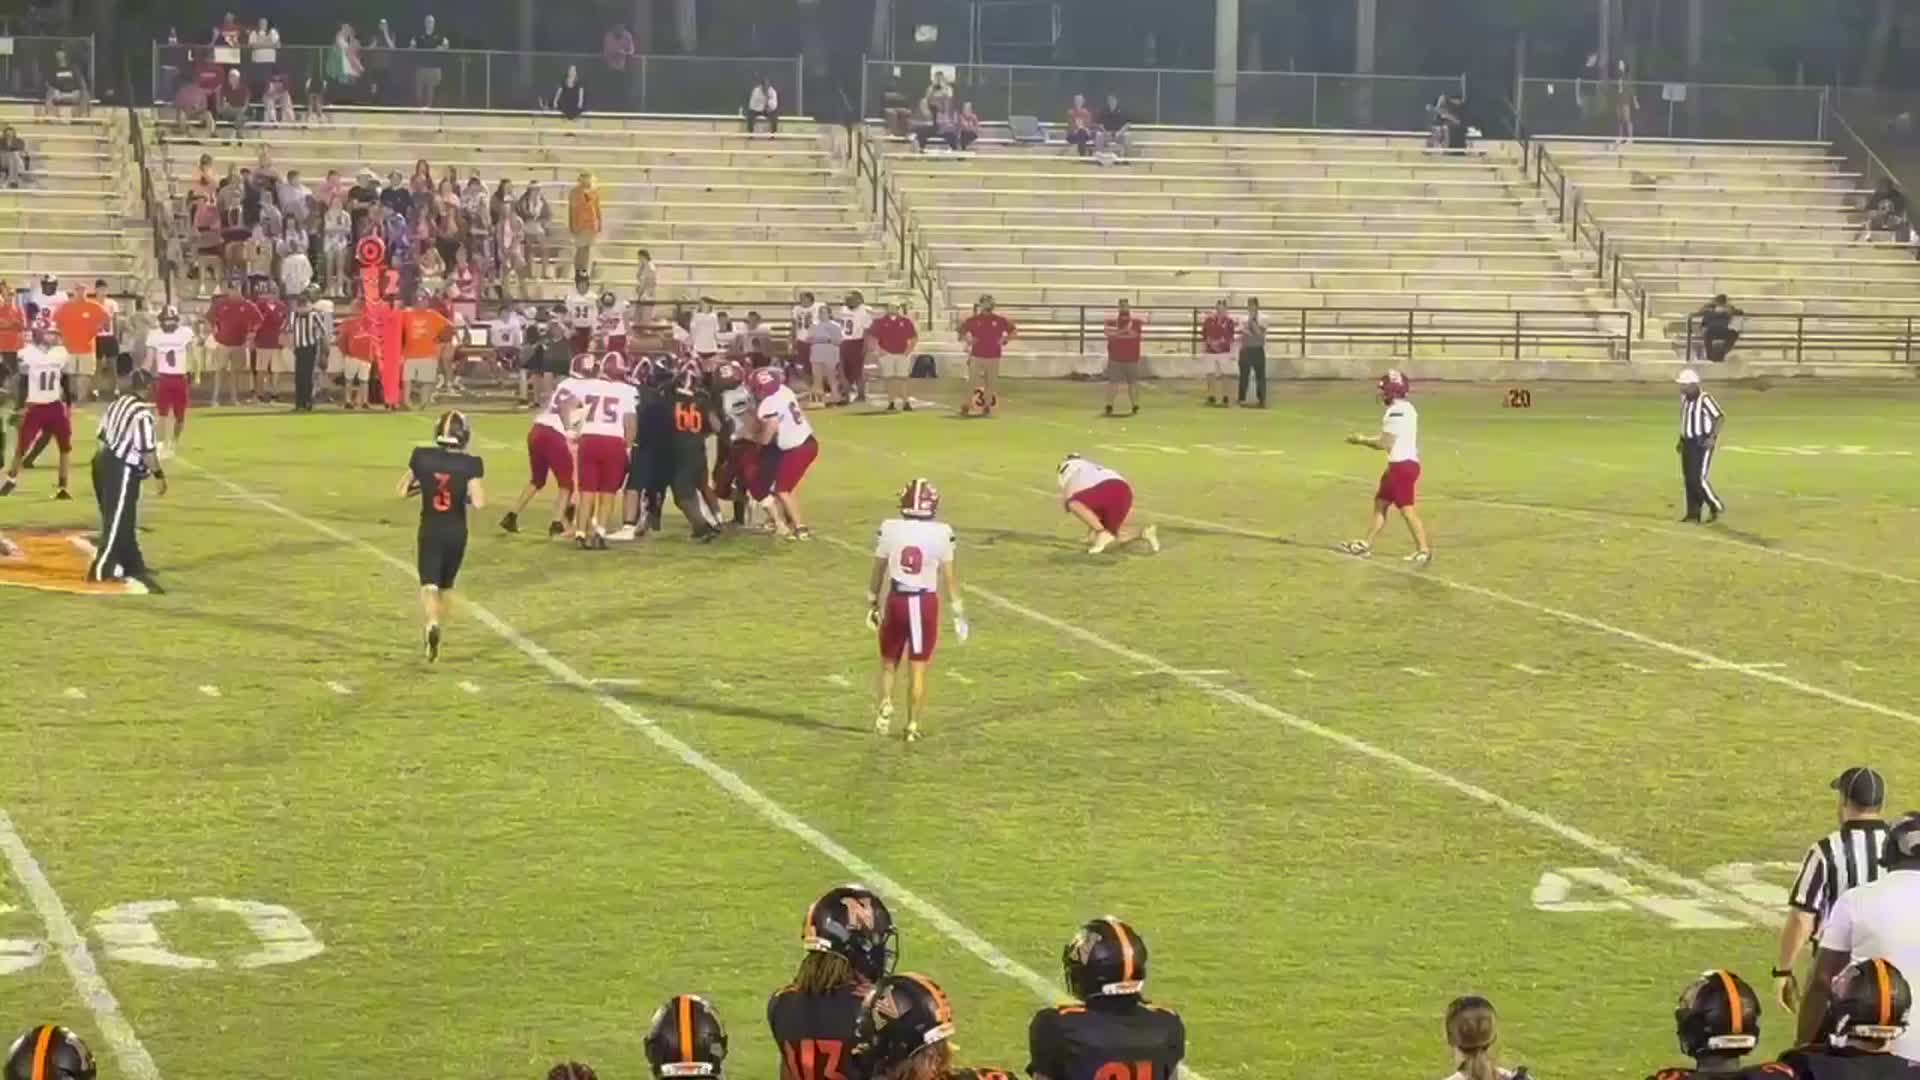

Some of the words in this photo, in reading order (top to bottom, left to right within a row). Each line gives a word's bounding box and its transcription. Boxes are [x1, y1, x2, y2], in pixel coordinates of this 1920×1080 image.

[585, 394, 620, 423] 75
[1509, 389, 1531, 409] 20
[674, 400, 703, 433] 66
[432, 472, 451, 512] 3
[901, 545, 923, 575] 9
[840, 896, 875, 931] N
